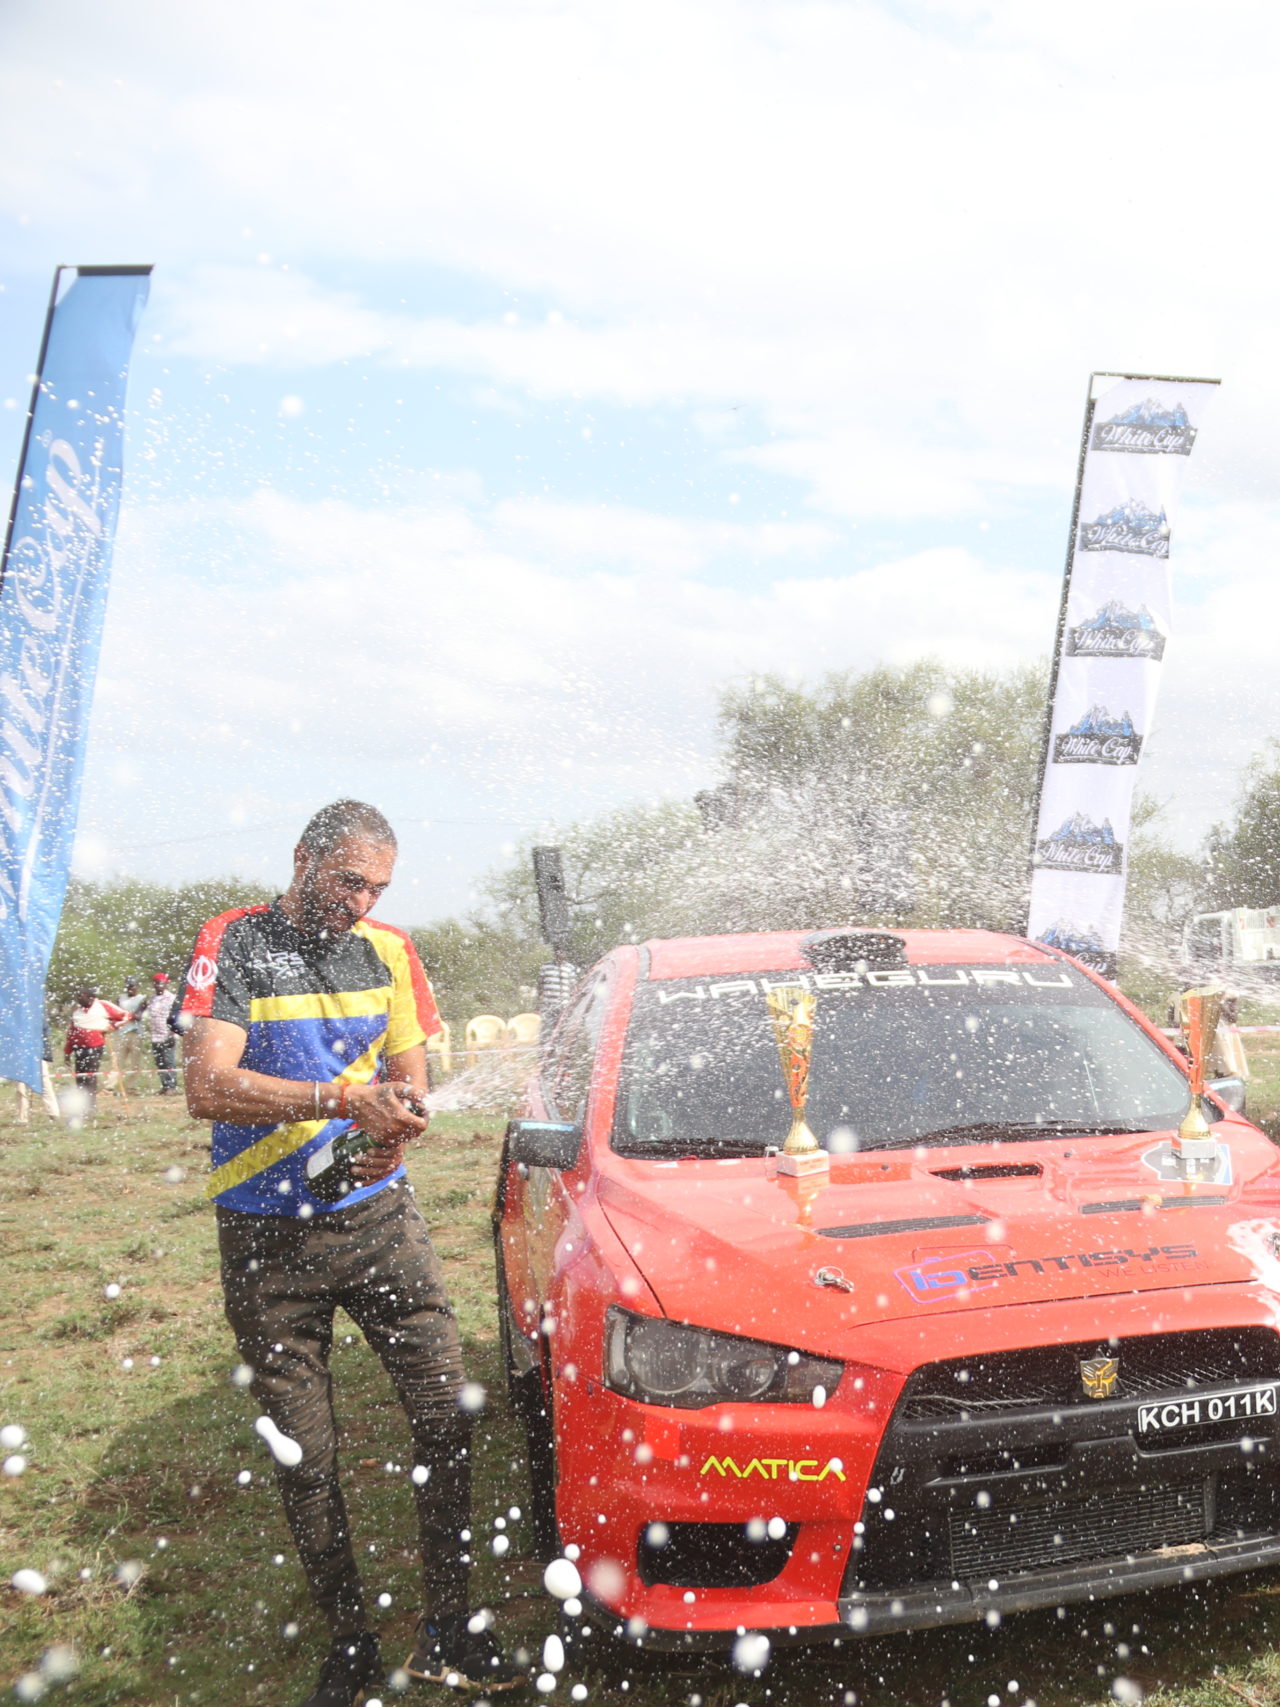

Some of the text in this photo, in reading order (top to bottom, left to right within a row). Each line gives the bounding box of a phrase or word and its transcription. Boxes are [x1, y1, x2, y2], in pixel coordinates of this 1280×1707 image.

[1102, 426, 1185, 451] White Cap
[1088, 525, 1138, 547] White
[1075, 630, 1117, 649] White
[1062, 737, 1132, 764] White Cap
[1044, 842, 1113, 871] White Cap
[658, 970, 1074, 1004] WAHEGURU
[1100, 1259, 1209, 1279] WE LISTEN
[1140, 1389, 1273, 1432] KCH 011K
[700, 1455, 846, 1482] MATICA
